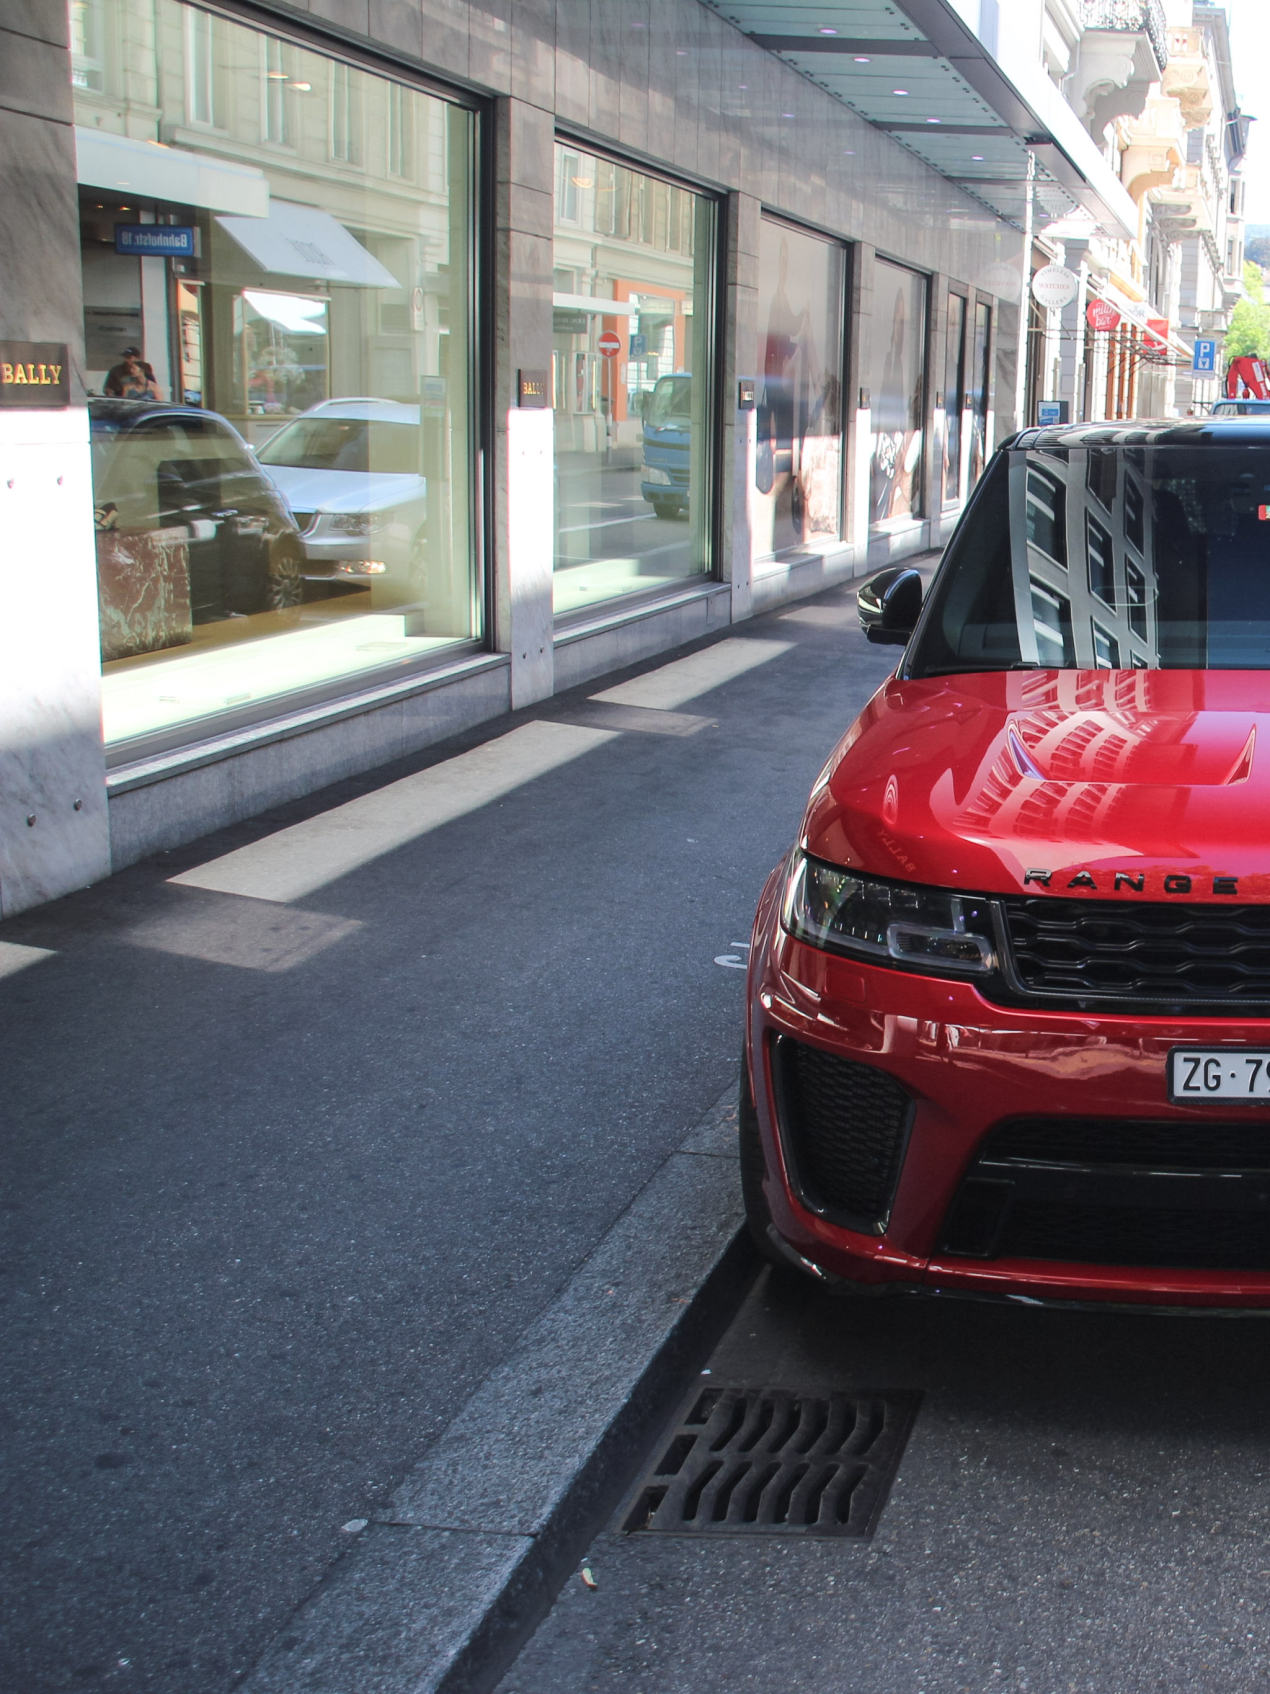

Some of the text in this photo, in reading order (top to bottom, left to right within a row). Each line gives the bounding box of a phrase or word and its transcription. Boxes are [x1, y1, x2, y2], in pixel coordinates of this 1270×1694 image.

[1200, 342, 1210, 357] P
[1, 363, 62, 385] BALLY
[1024, 867, 1239, 894] RANGE
